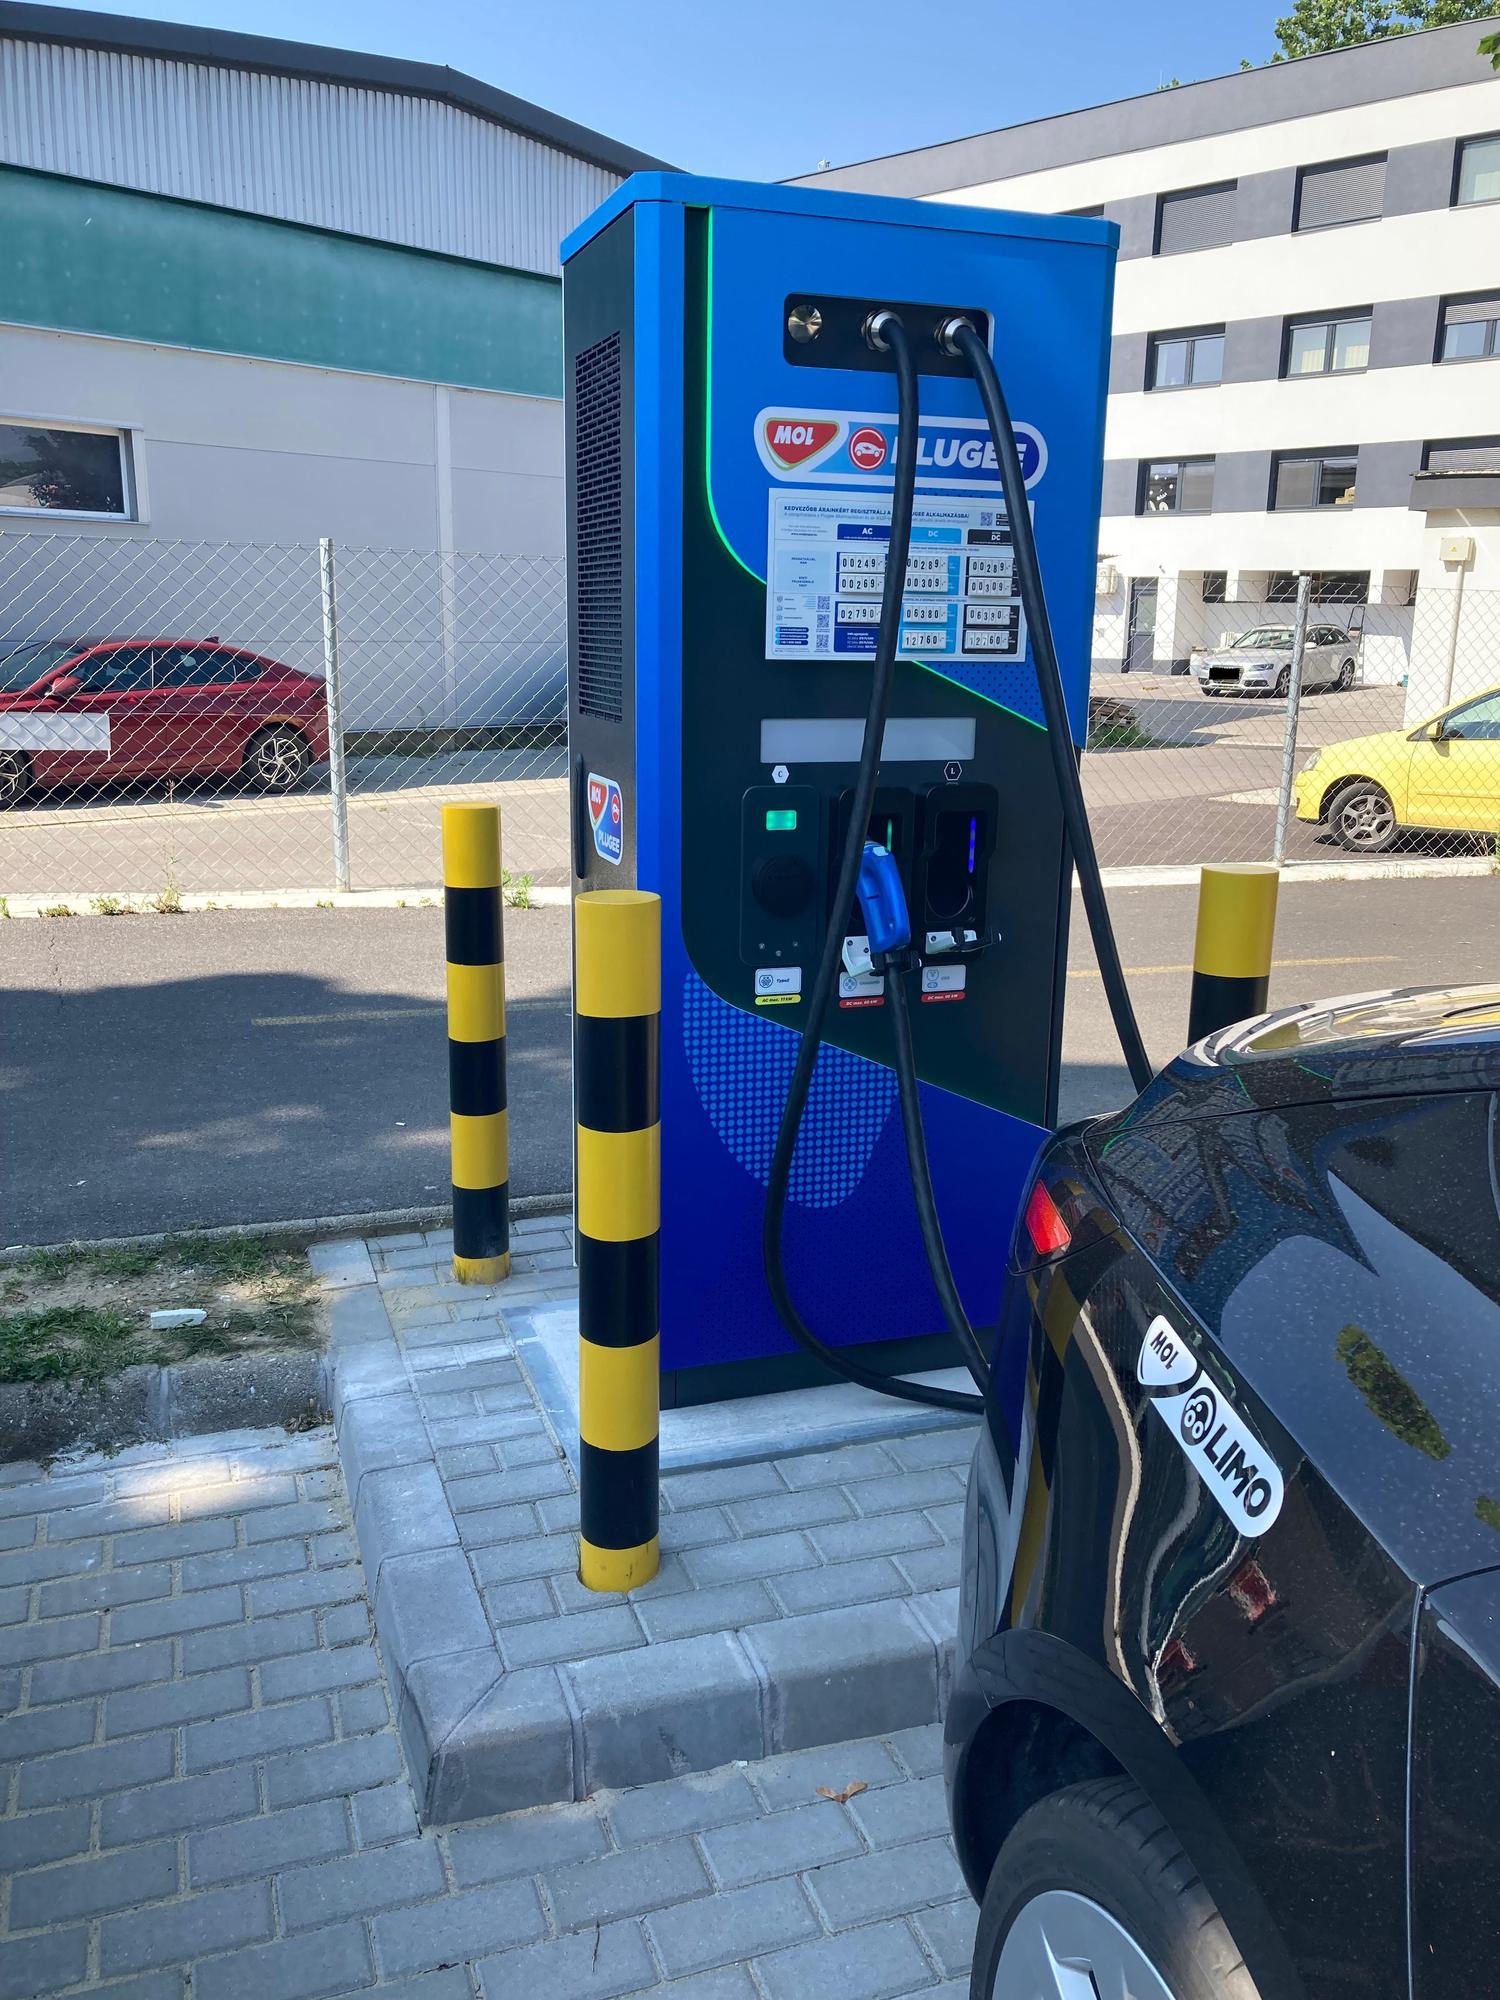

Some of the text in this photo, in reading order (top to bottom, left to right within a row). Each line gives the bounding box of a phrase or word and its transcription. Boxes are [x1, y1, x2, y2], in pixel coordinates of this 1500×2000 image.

[774, 425, 815, 446] MOL
[861, 527, 873, 535] AC
[598, 829, 621, 854] PLUGEE
[1150, 1330, 1180, 1370] MOL
[1203, 1423, 1272, 1518] LIMO
